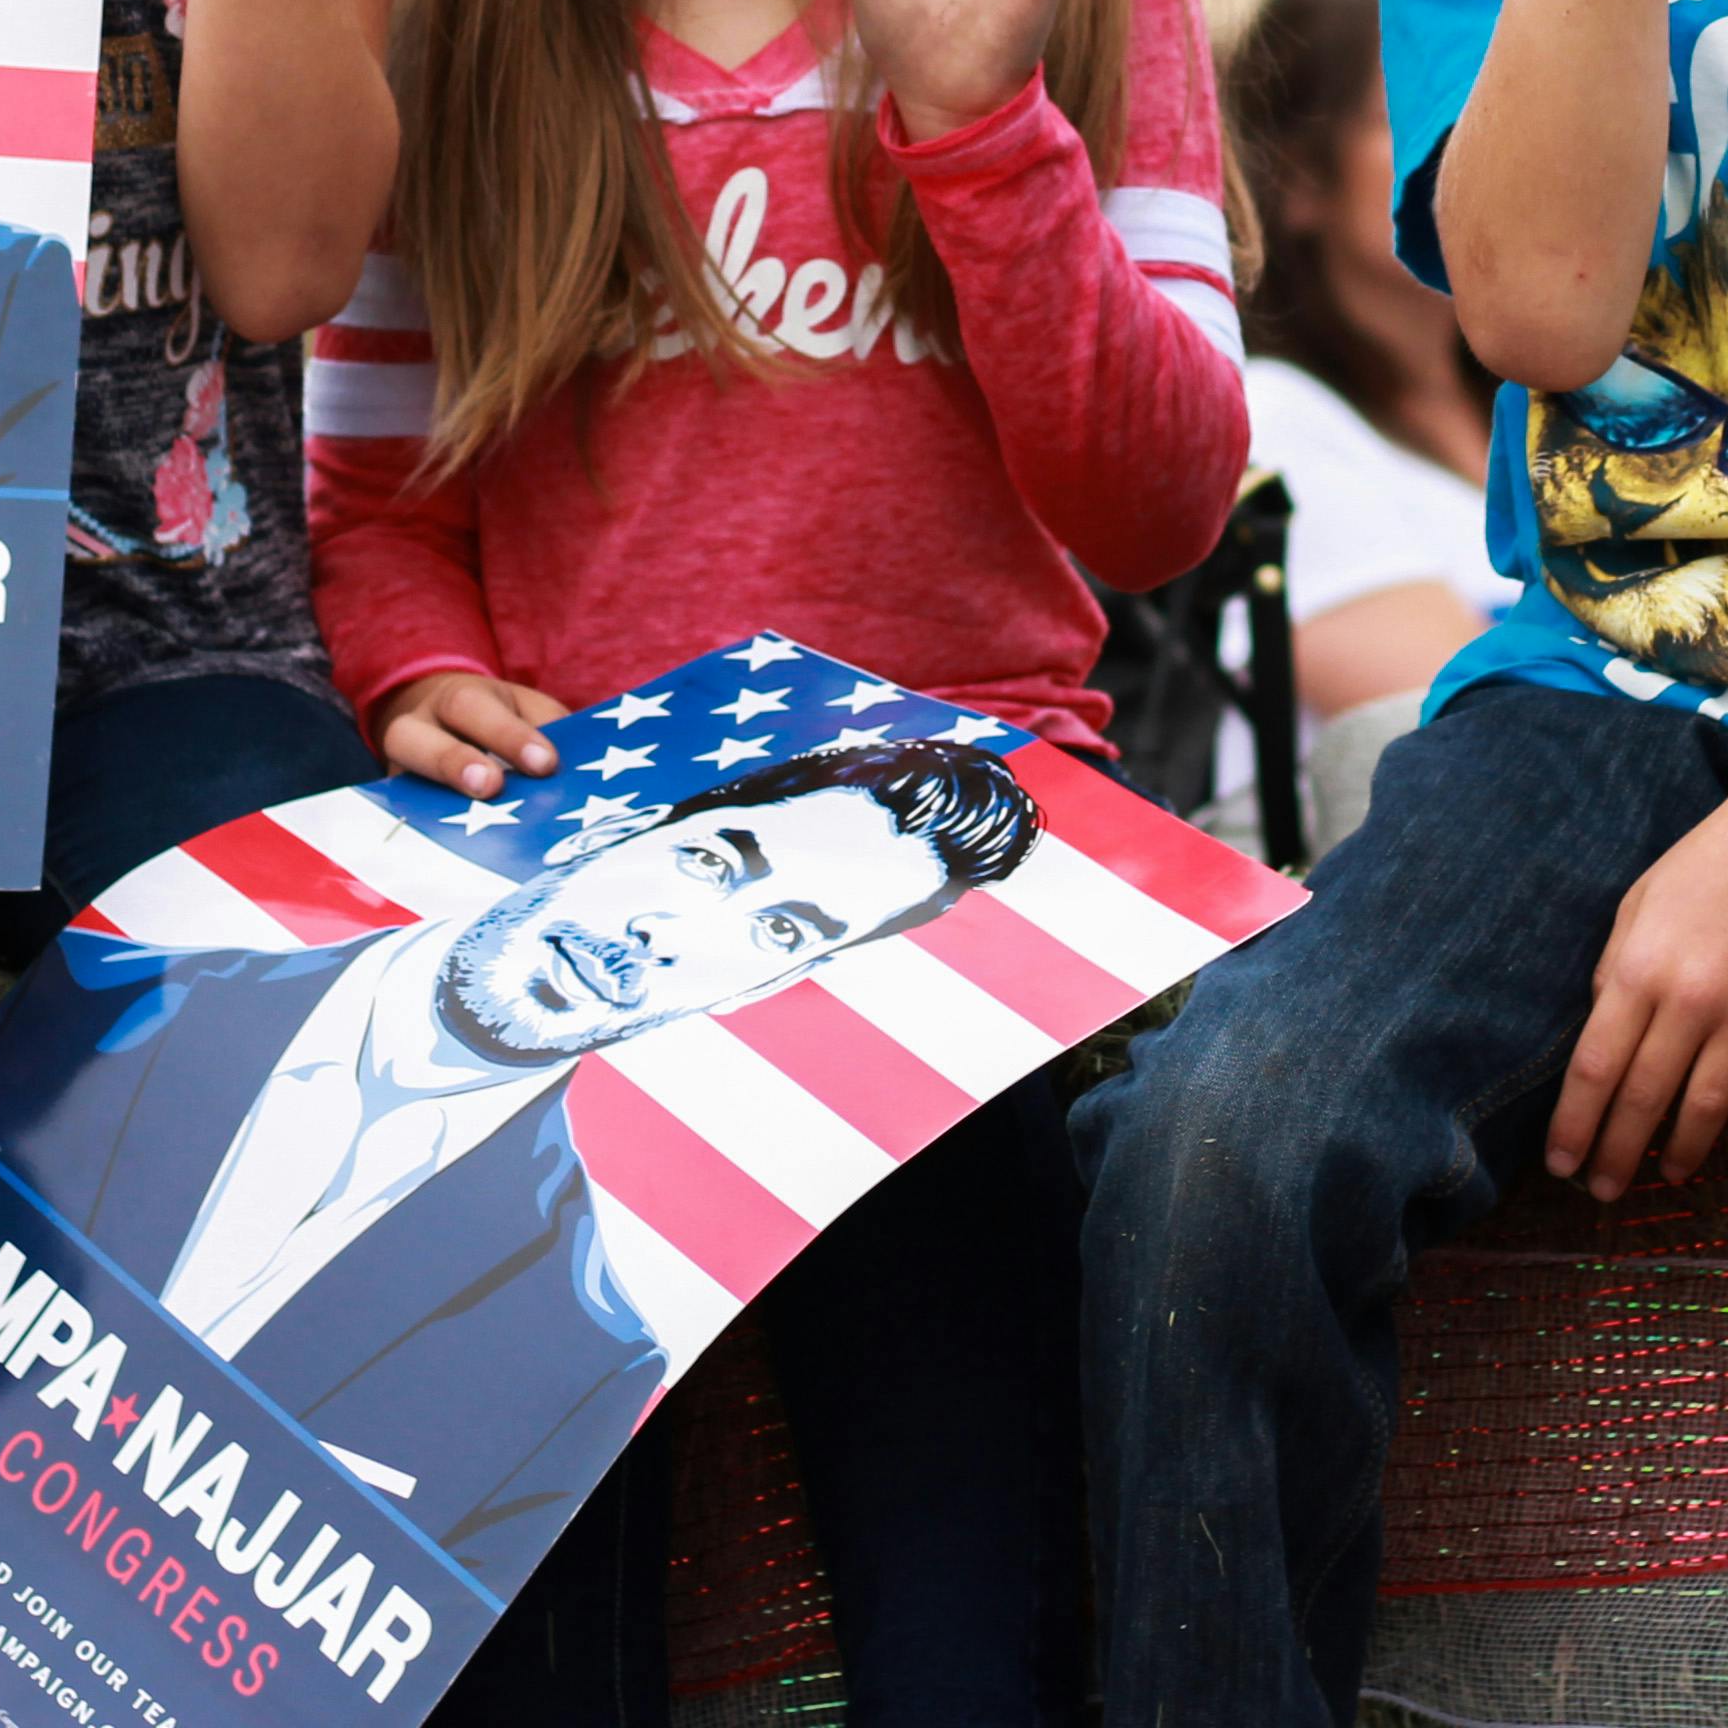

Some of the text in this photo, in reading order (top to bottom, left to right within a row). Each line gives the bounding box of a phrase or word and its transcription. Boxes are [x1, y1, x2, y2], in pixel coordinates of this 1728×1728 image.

[13, 1587, 73, 1639] JOIN
[76, 1641, 128, 1692] OUR
[113, 1385, 431, 1703] NAJJAR
